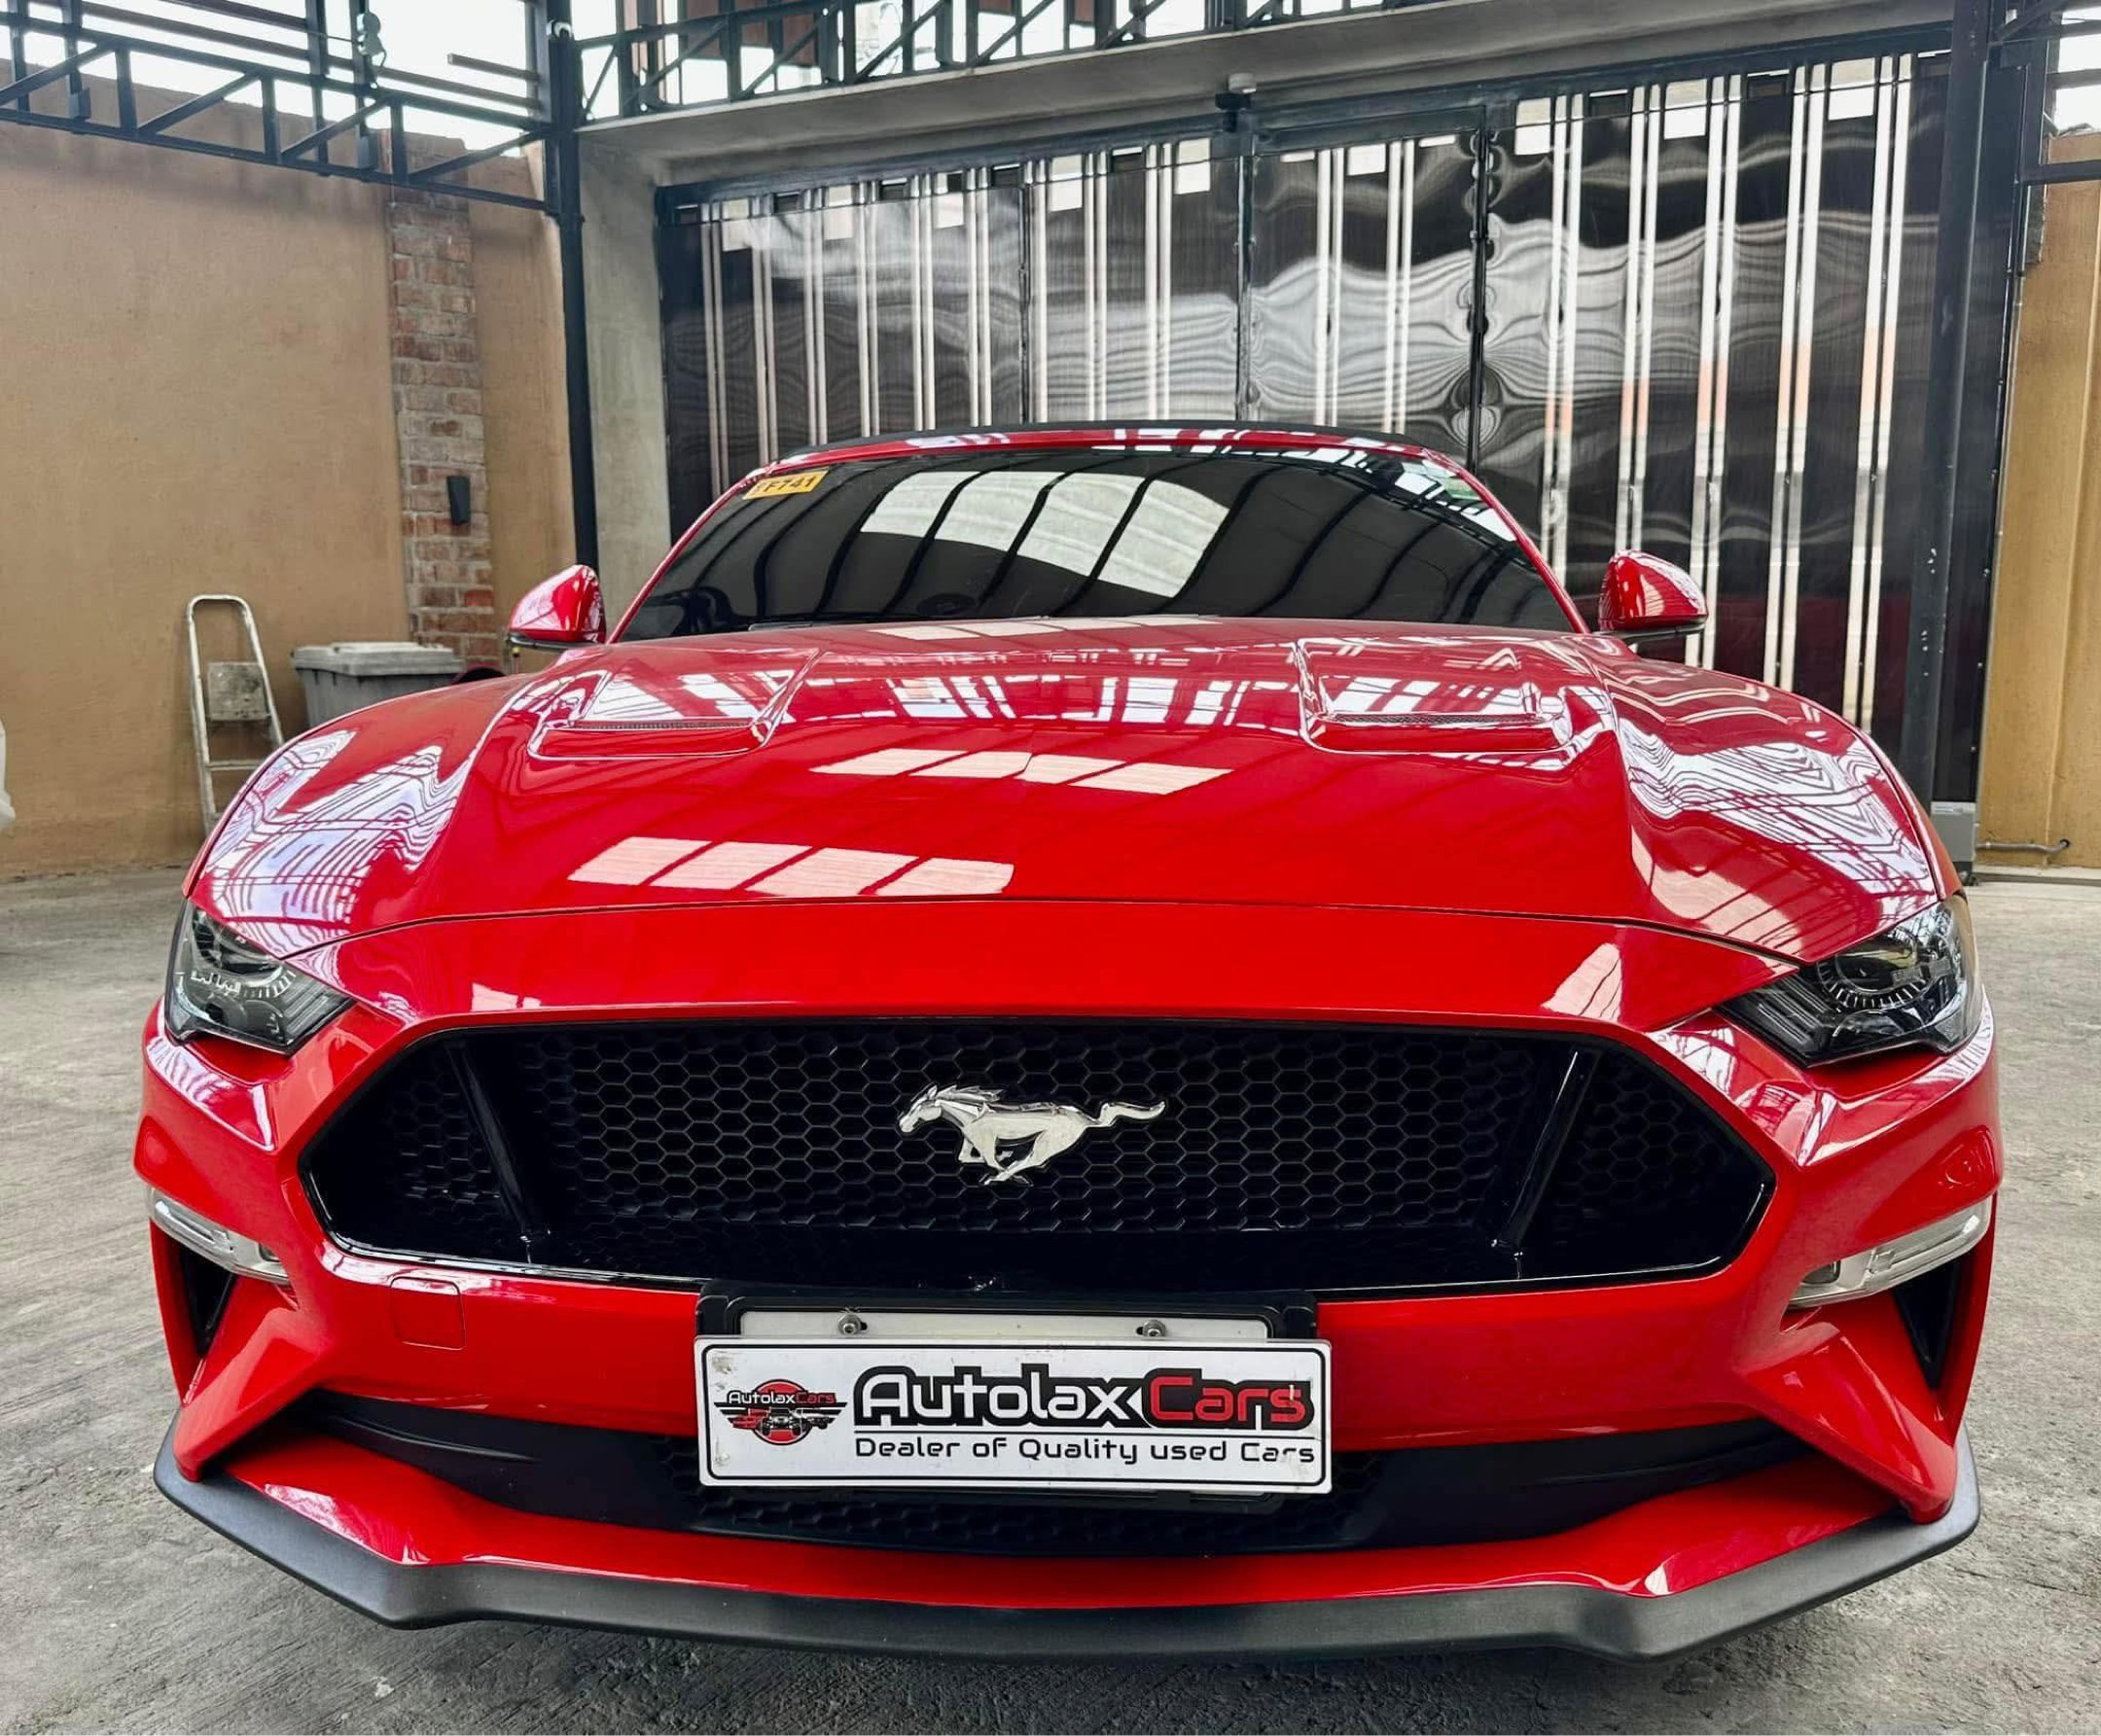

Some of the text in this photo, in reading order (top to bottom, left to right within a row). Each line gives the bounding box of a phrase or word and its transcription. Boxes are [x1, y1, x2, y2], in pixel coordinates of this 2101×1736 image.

[855, 1435, 1315, 1466] Dealer of Quality used Cars
